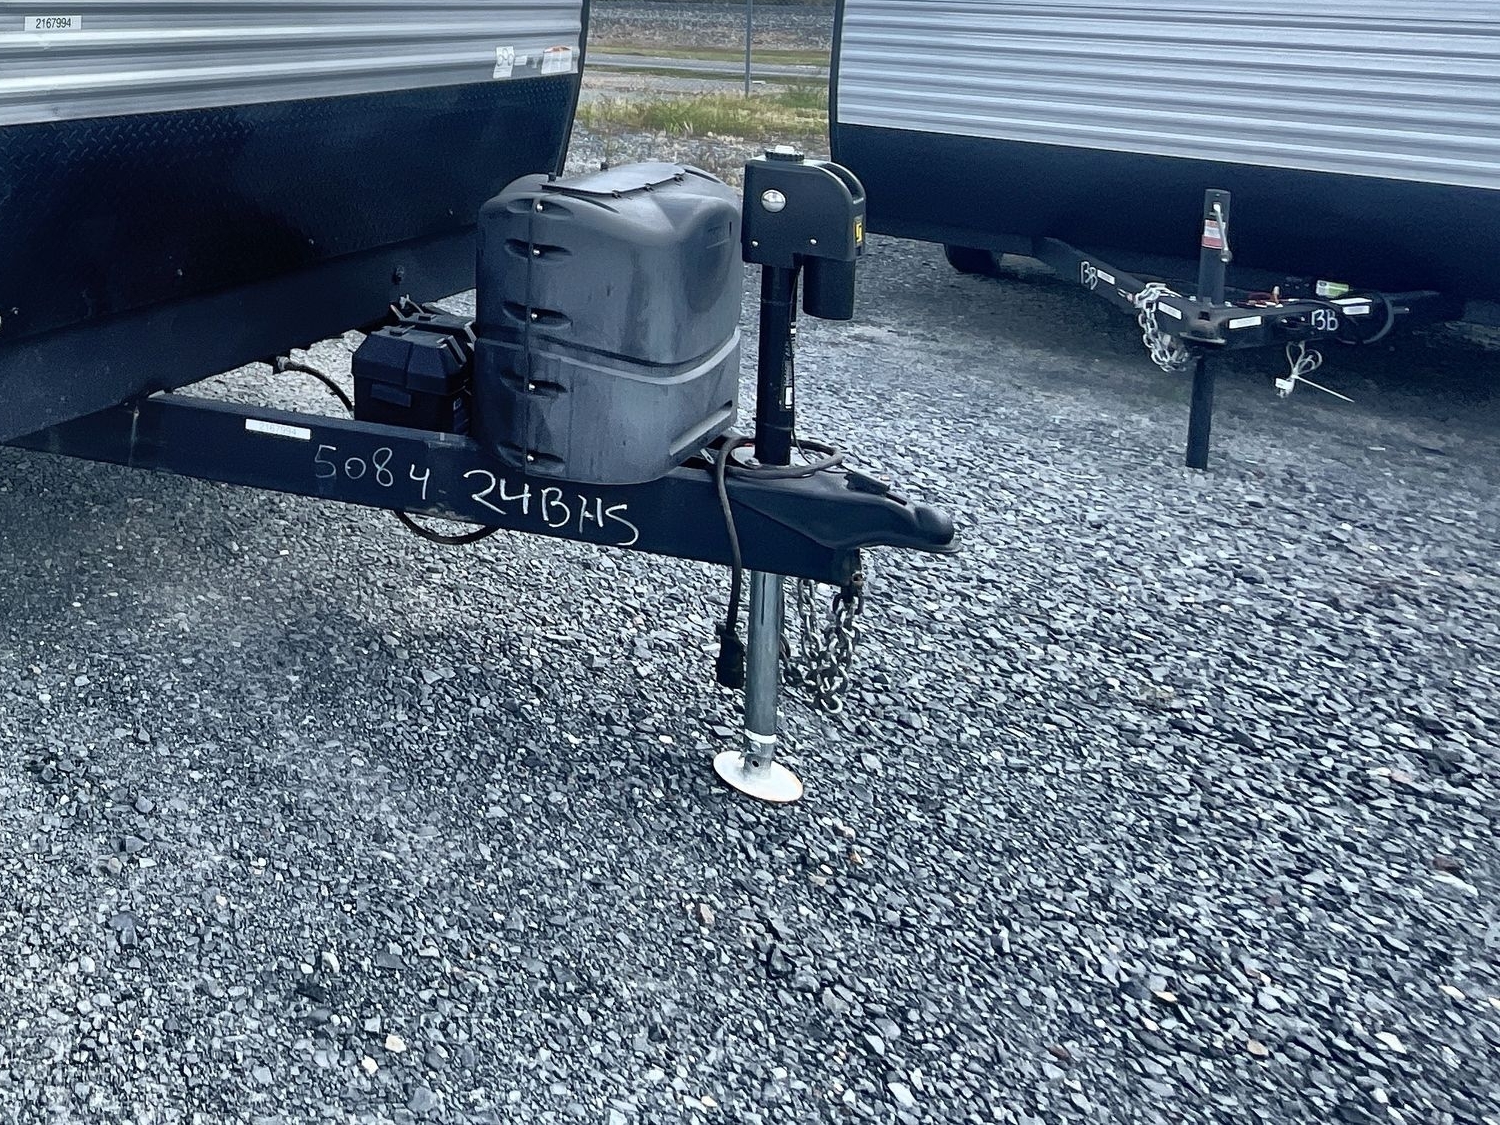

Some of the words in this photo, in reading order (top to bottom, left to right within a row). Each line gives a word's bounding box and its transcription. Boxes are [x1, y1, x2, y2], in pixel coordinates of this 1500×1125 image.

[35, 17, 71, 29] 2167994
[314, 444, 431, 500] 5084
[463, 469, 639, 546] 24BHS
